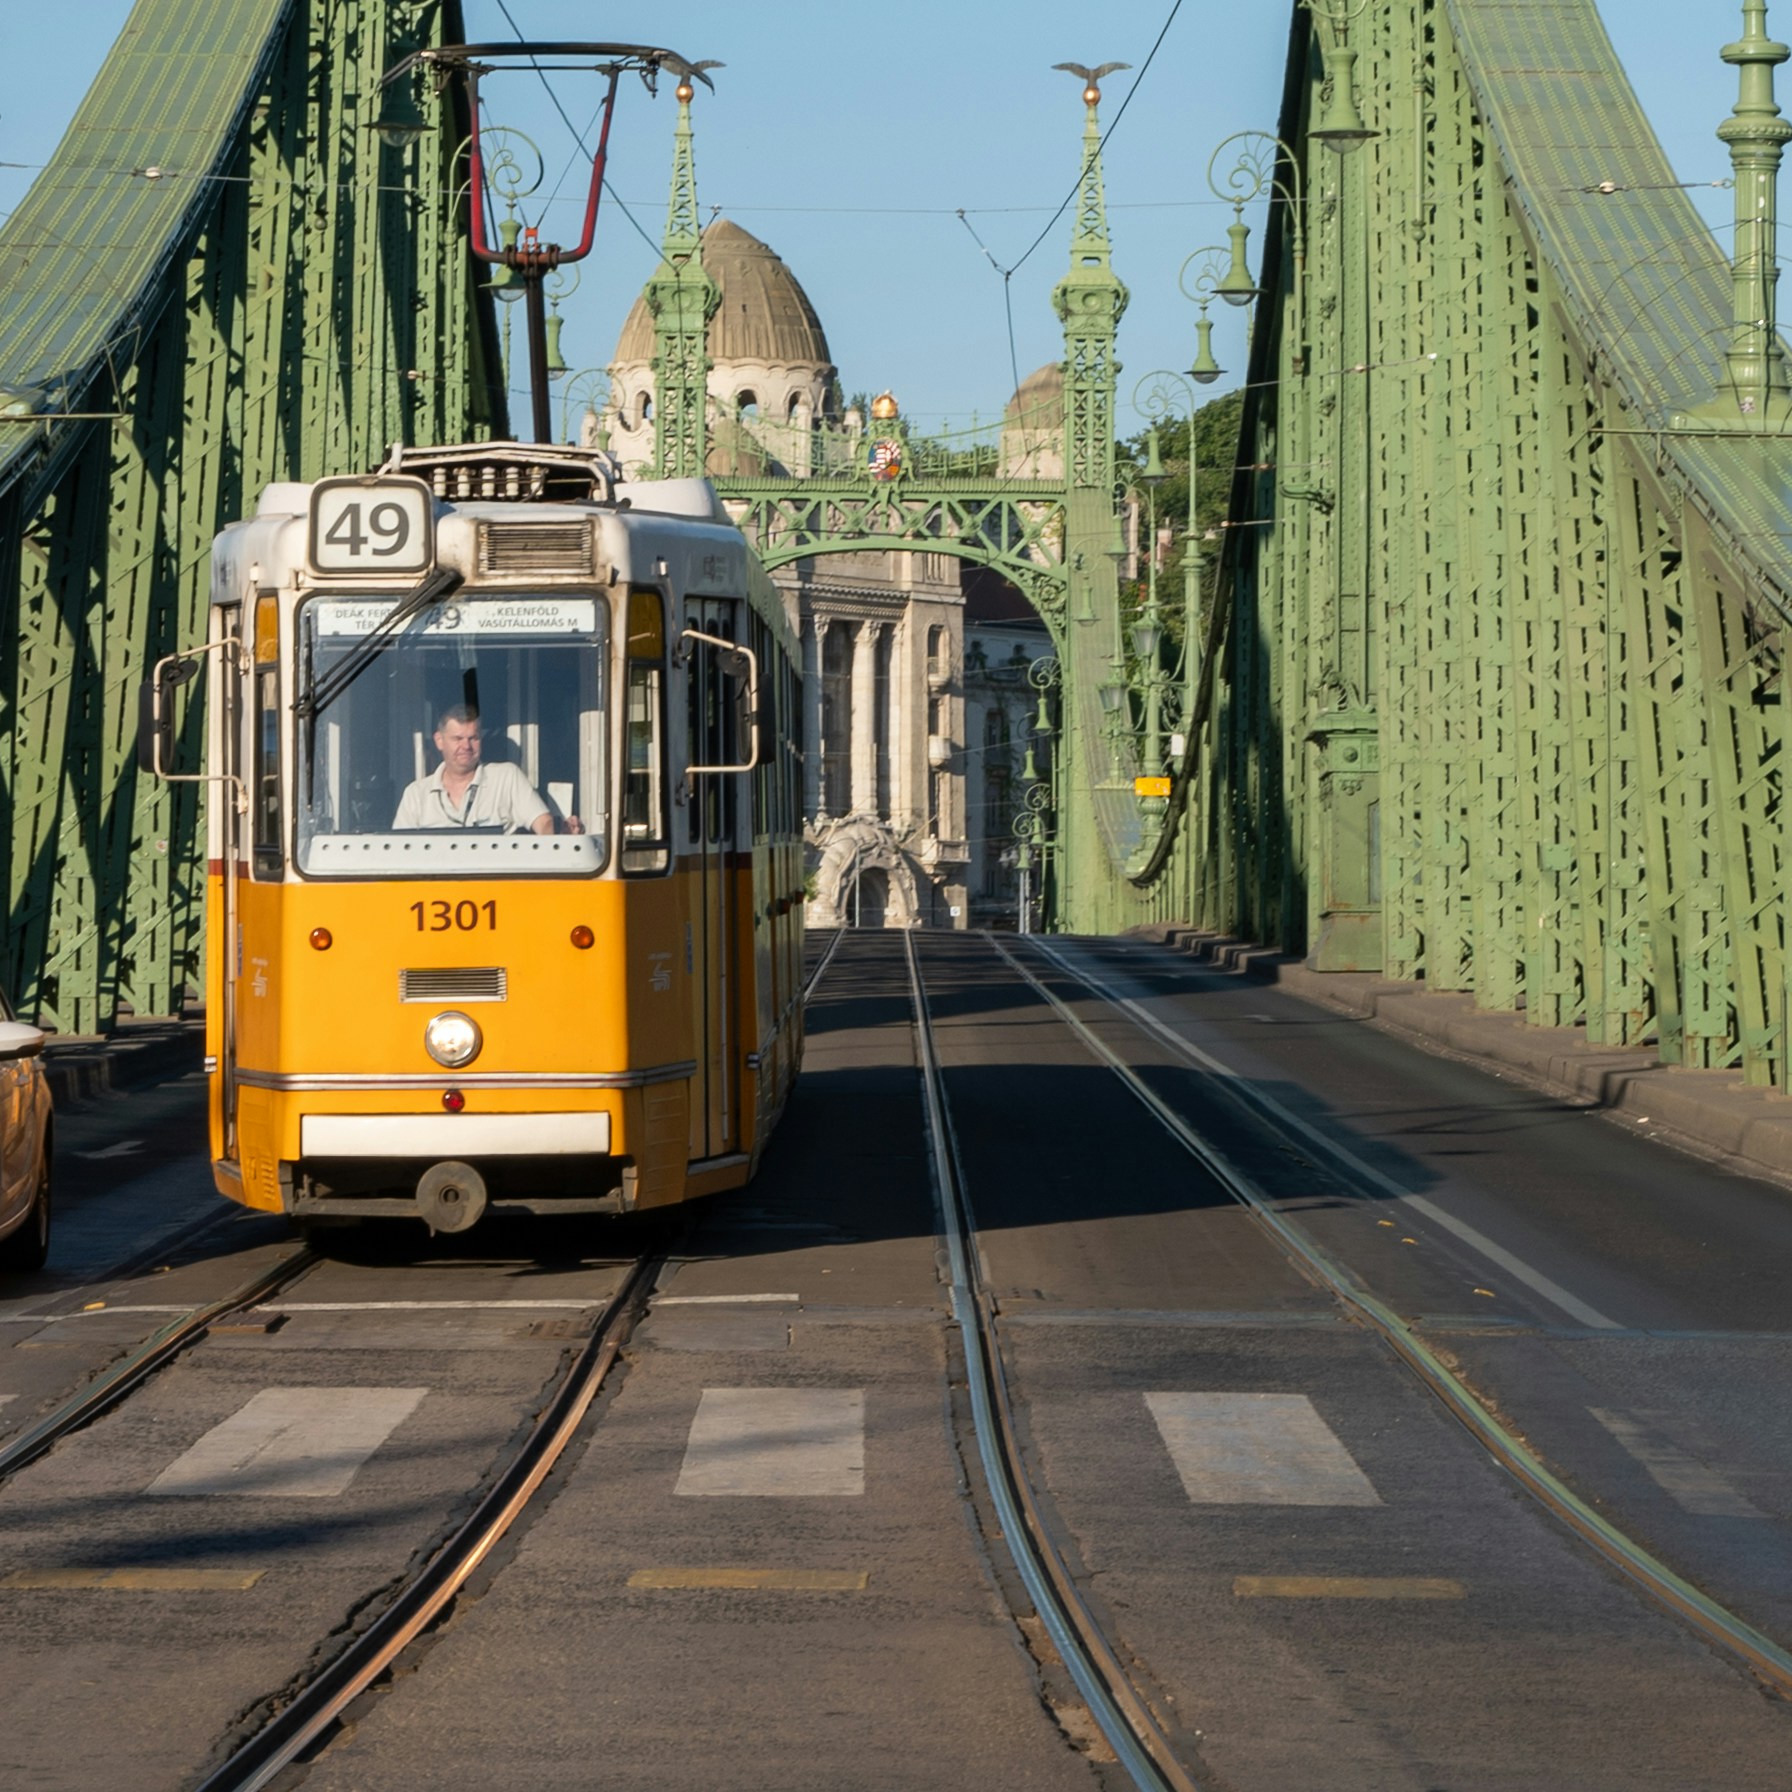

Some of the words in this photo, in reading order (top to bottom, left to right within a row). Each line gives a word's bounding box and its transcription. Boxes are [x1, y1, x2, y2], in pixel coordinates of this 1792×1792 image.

[325, 502, 410, 556] 49
[335, 607, 364, 618] DEÁK
[497, 606, 559, 617] KELENFÖLD
[426, 606, 461, 630] 49
[568, 618, 578, 627] M
[355, 619, 375, 629] TÉR
[410, 899, 496, 931] 1301
